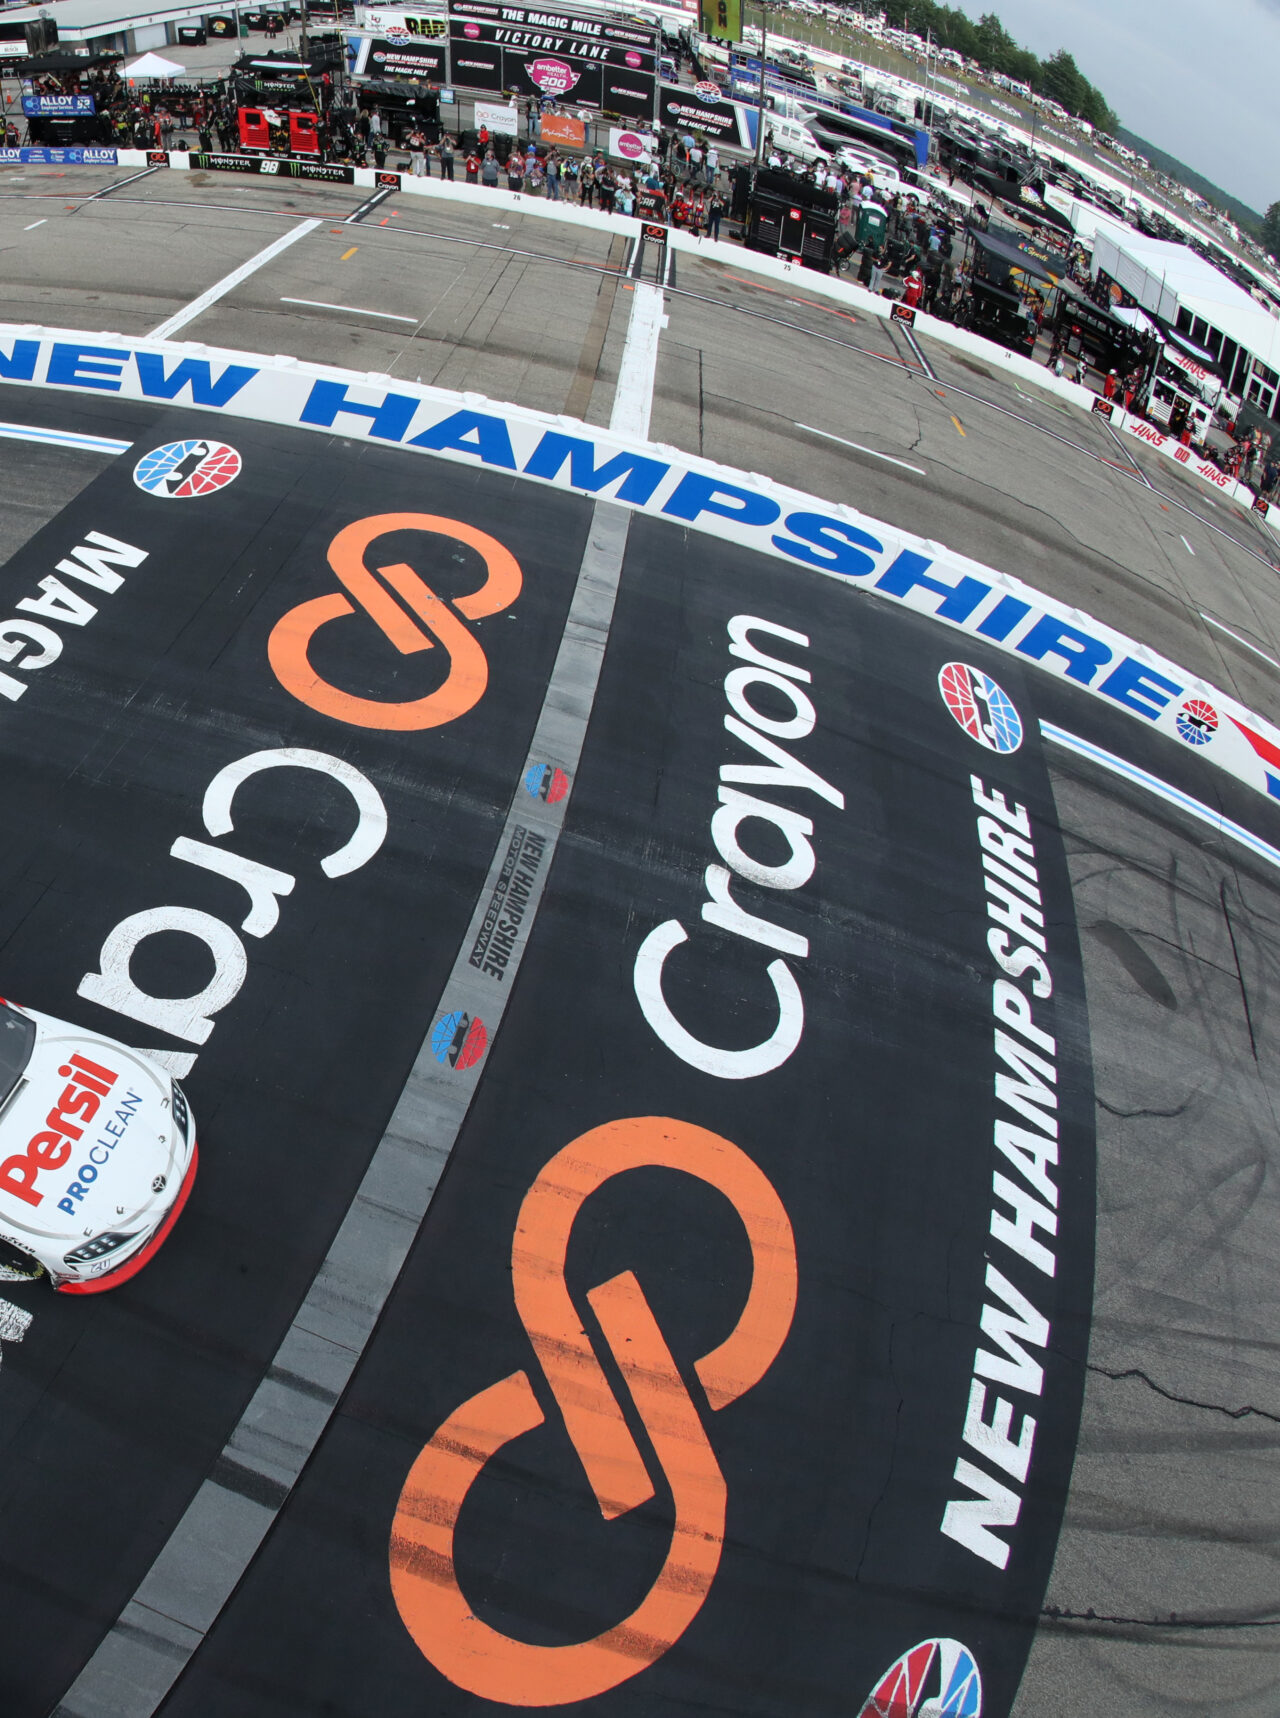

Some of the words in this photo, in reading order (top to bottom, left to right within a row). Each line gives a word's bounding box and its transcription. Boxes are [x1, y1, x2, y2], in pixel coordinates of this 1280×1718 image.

[501, 8, 524, 21] THE
[527, 12, 568, 29] MAGIC
[571, 19, 602, 36] MILE
[495, 29, 564, 51] VICTORY
[570, 42, 610, 60] LANE
[400, 55, 438, 65] HAMPSHIRE
[394, 66, 412, 75] MAGIC
[413, 68, 428, 76] MILE
[536, 64, 568, 75] ambetter
[263, 81, 296, 90] MONSTER
[539, 75, 567, 88] 200
[40, 96, 73, 106] ALLOY
[491, 112, 517, 124] Crayon
[680, 105, 696, 114] NEW
[696, 109, 734, 125] HAMPSHIRE
[677, 118, 688, 126] THE
[688, 121, 707, 131] MAGIC
[706, 126, 722, 135] MILE
[618, 140, 643, 151] ambetter
[83, 149, 115, 160] ALLOY
[210, 157, 251, 167] MONSTER
[260, 161, 279, 174] 98
[302, 166, 345, 177] MONSTER
[378, 182, 399, 190] Crayon
[643, 234, 665, 244] Crayon
[892, 313, 912, 327] Crayon
[1093, 407, 1112, 422] Crayon
[299, 379, 1184, 721] HAMPSHIRE
[501, 825, 526, 877] MOTOR
[521, 830, 546, 875] NEW
[634, 615, 844, 1079] Crayon
[469, 880, 507, 968] SPEEDWAY
[482, 868, 537, 981] HAMPSHIRE
[970, 774, 1061, 1278] HAMPSHIRE
[57, 1090, 143, 1217] PROCLEAN
[940, 1258, 1049, 1571] NEW
